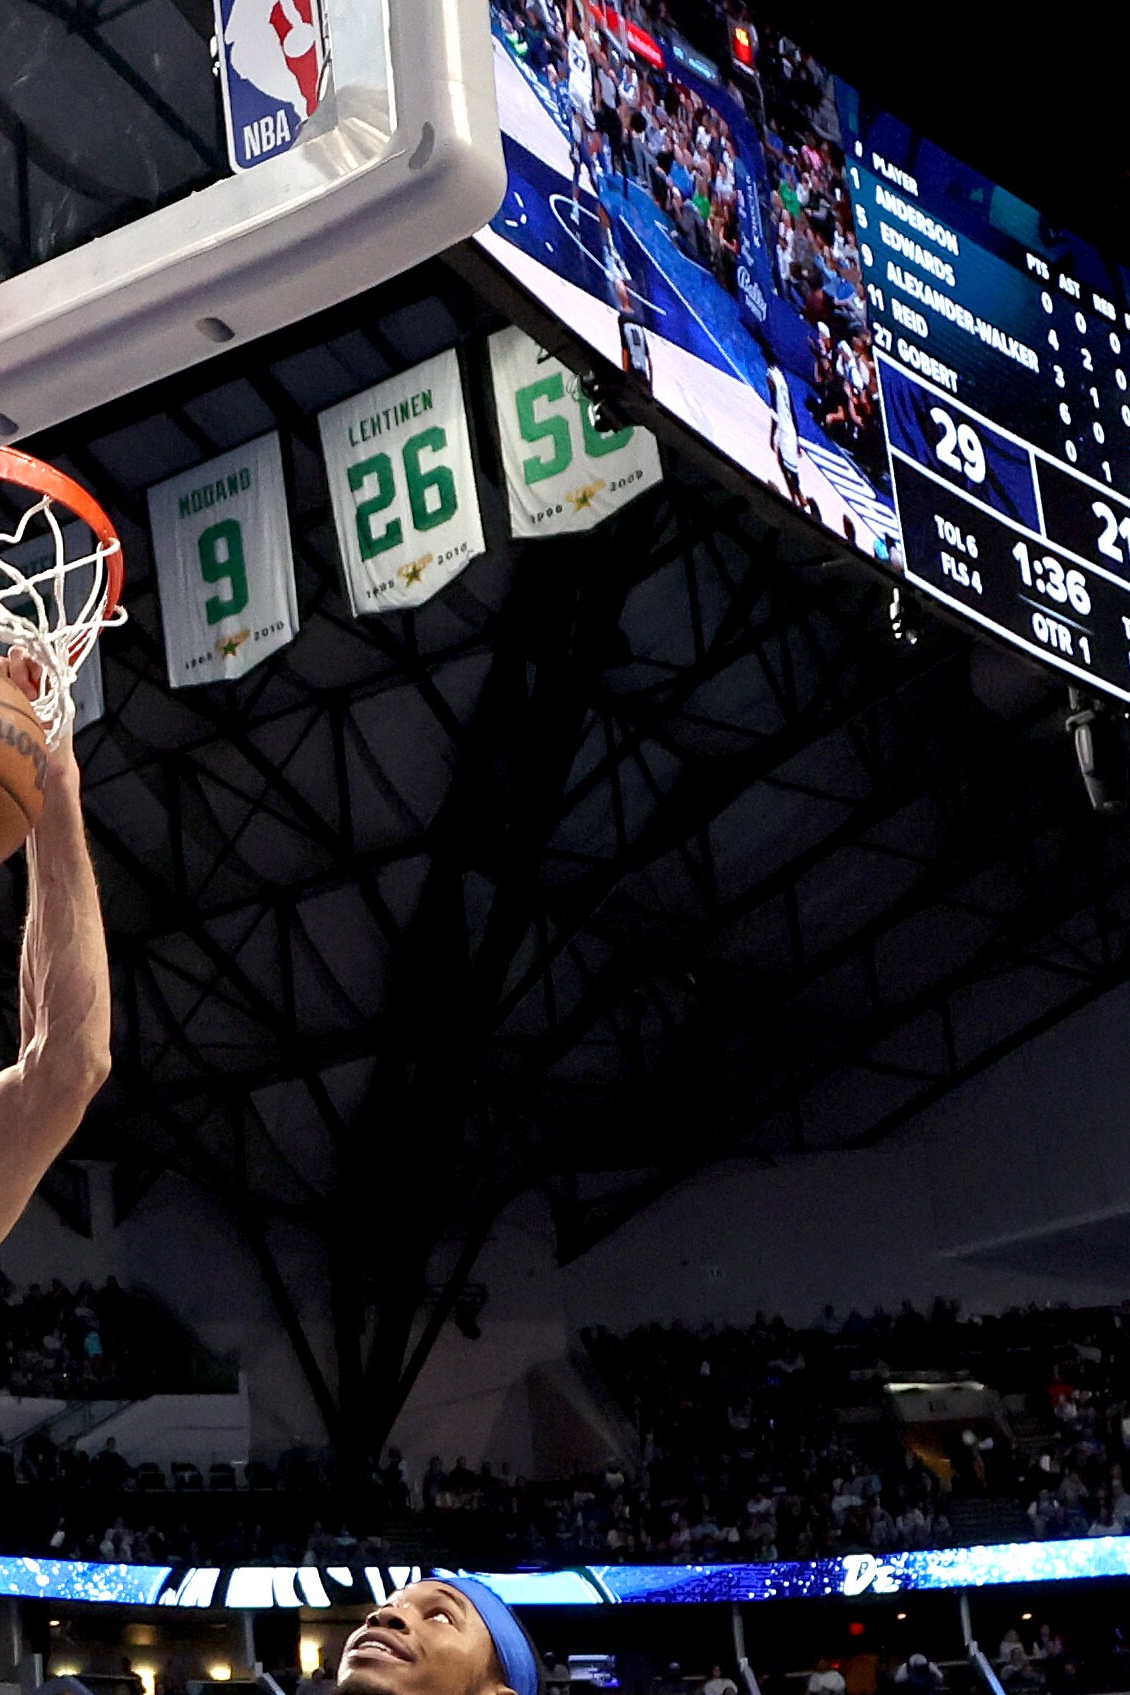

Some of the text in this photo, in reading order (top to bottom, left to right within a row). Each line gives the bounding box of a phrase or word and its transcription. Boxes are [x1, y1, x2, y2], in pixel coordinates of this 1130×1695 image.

[242, 109, 291, 160] NBA
[850, 167, 1121, 354] 1 ANDERSON 0 0 0
[872, 152, 918, 196] PLAYER
[1026, 252, 1050, 280] PTS
[1059, 273, 1080, 299] AST
[855, 204, 1127, 391] 5 EDWARDS 4 2 0
[861, 244, 874, 267] 9
[887, 261, 1040, 374] ALEXANDER-WALKER
[1054, 365, 1065, 388] 3
[1089, 387, 1100, 409] 1
[867, 283, 1105, 444] 11 REID 6 0
[873, 322, 1112, 483] 27 GOBERT 0 1
[348, 389, 434, 446] LEHTINEN
[930, 407, 986, 484] 29
[179, 467, 251, 519] MODANO
[346, 425, 458, 563] 26
[934, 514, 978, 558] TOL 6
[198, 518, 249, 626] 9
[940, 551, 983, 595] FLS 4
[1012, 541, 1091, 616] 1:36
[1032, 612, 1091, 665] QTR 1
